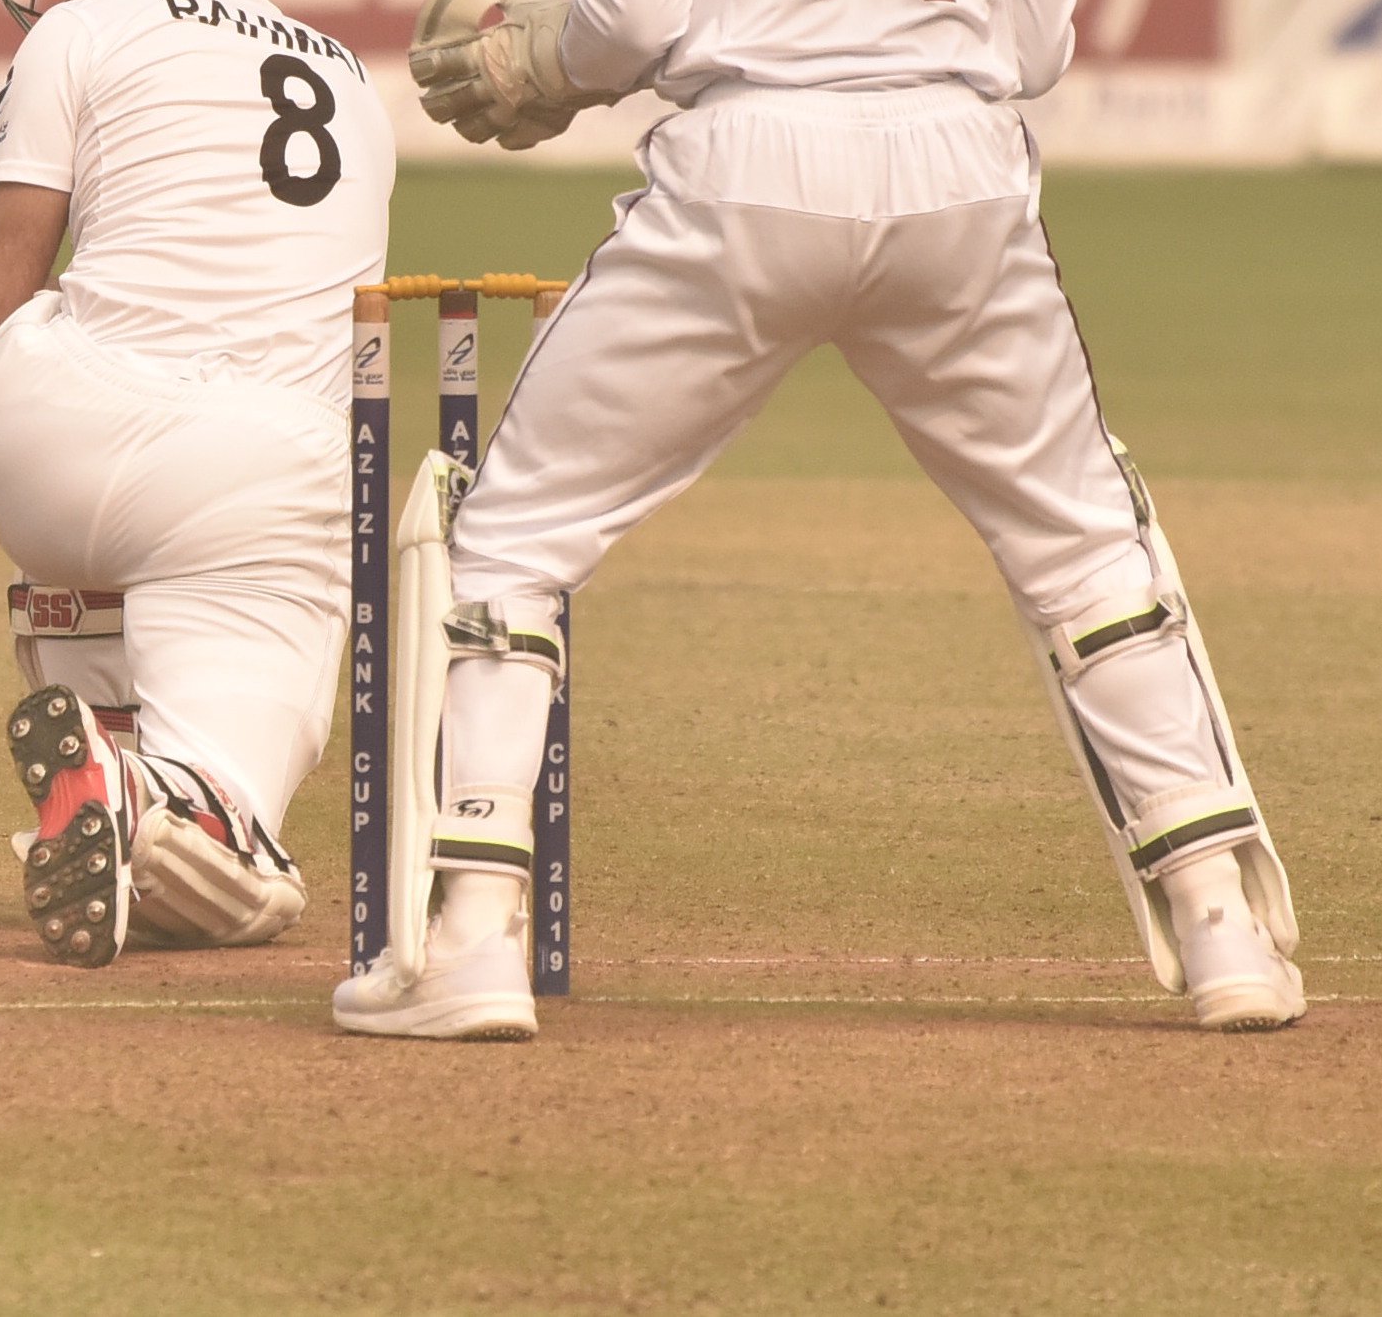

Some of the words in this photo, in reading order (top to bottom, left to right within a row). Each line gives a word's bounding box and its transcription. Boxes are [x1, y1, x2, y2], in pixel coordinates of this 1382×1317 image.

[260, 53, 341, 207] 8
[356, 423, 375, 564] AZIZI
[33, 593, 73, 628] SS
[355, 603, 374, 714] BANK
[354, 752, 371, 833] CUP
[548, 743, 565, 824] CUP
[353, 872, 369, 976] 2019
[548, 862, 564, 972] 2019
